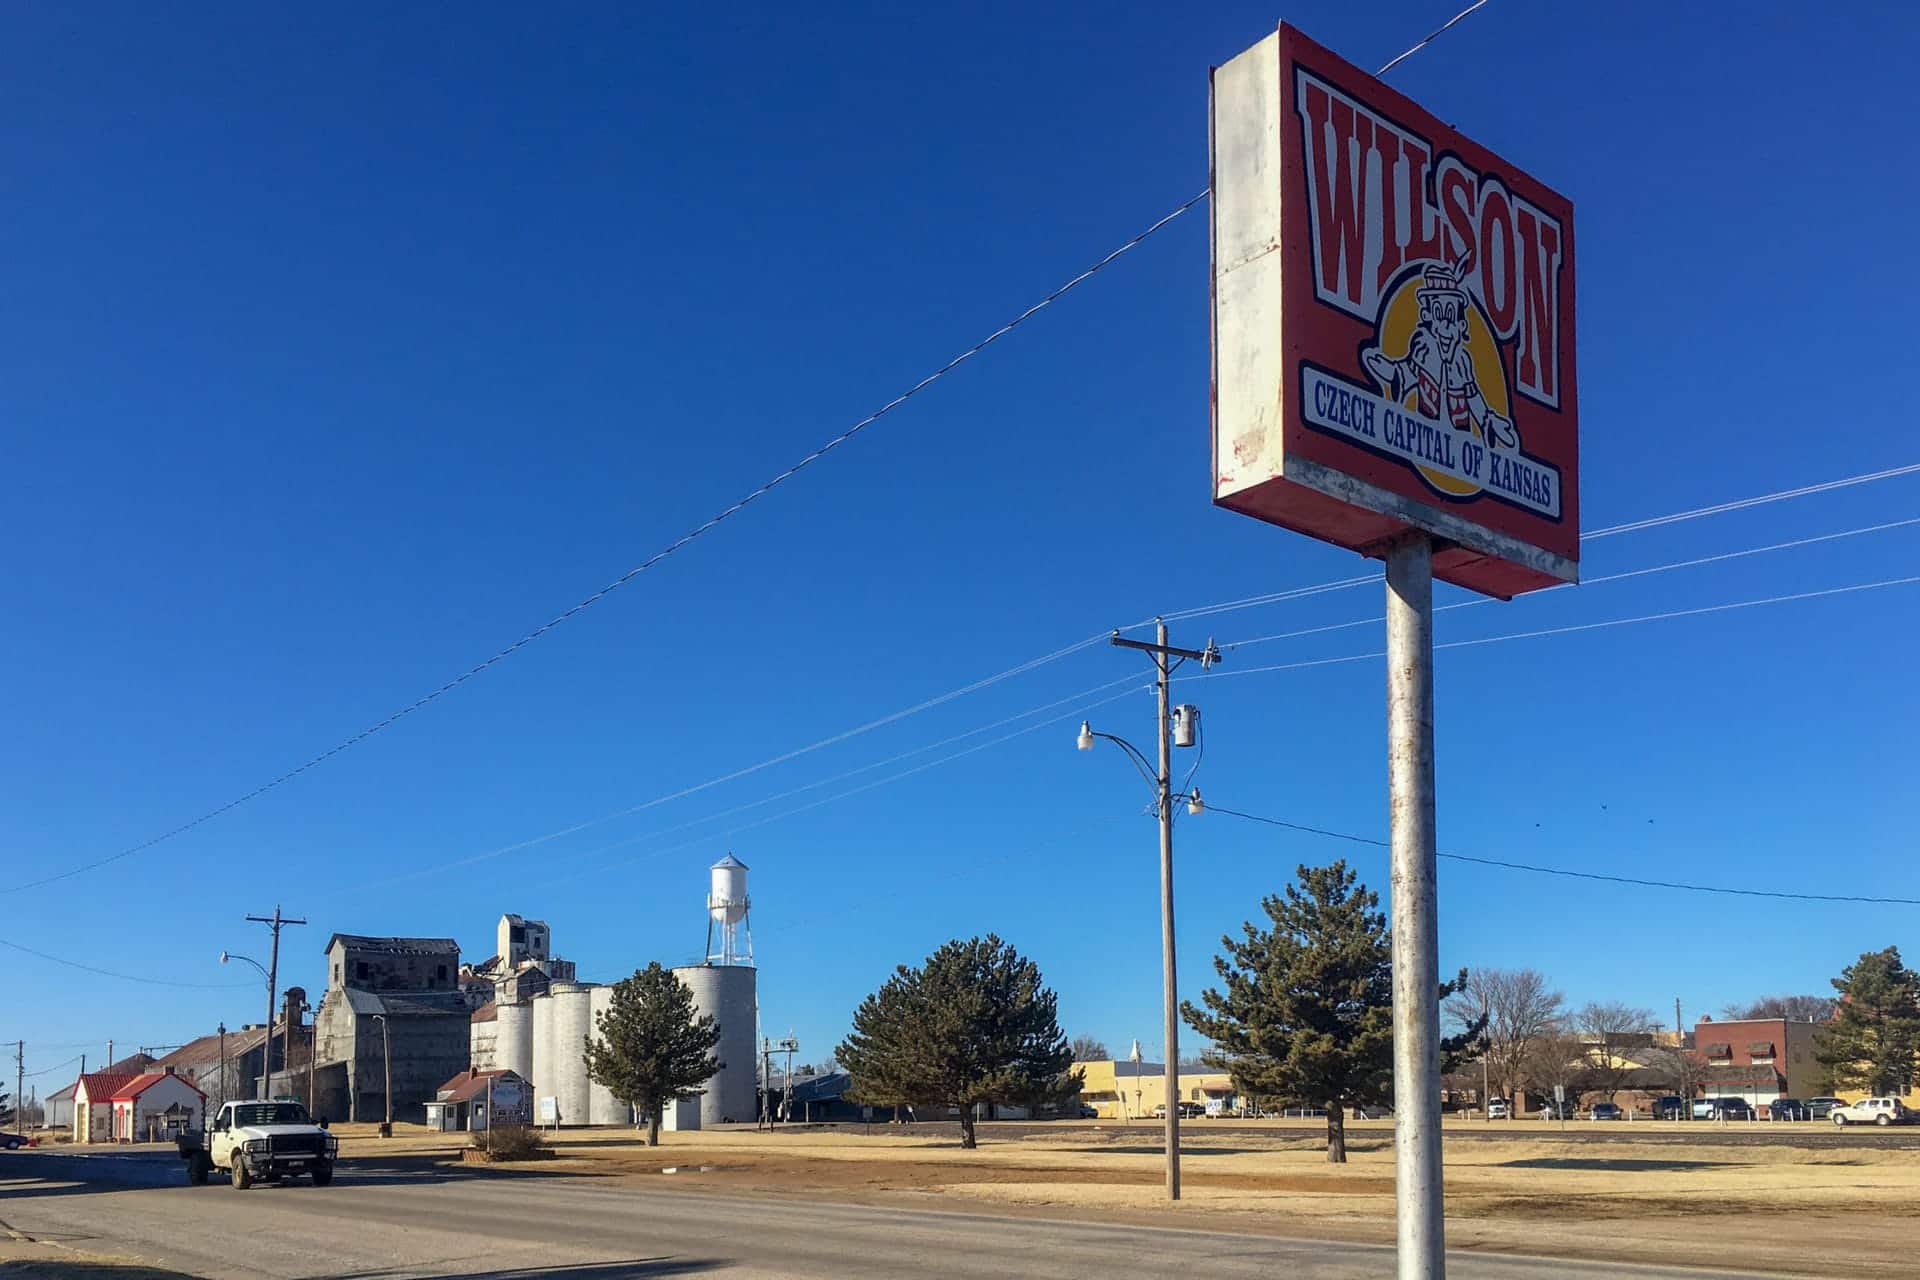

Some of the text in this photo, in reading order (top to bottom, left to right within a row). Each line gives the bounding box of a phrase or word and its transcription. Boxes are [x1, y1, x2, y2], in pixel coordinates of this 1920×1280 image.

[1304, 80, 1558, 397] WILSON
[1314, 380, 1551, 508] CZECH CAPITAL OF KANSAS
